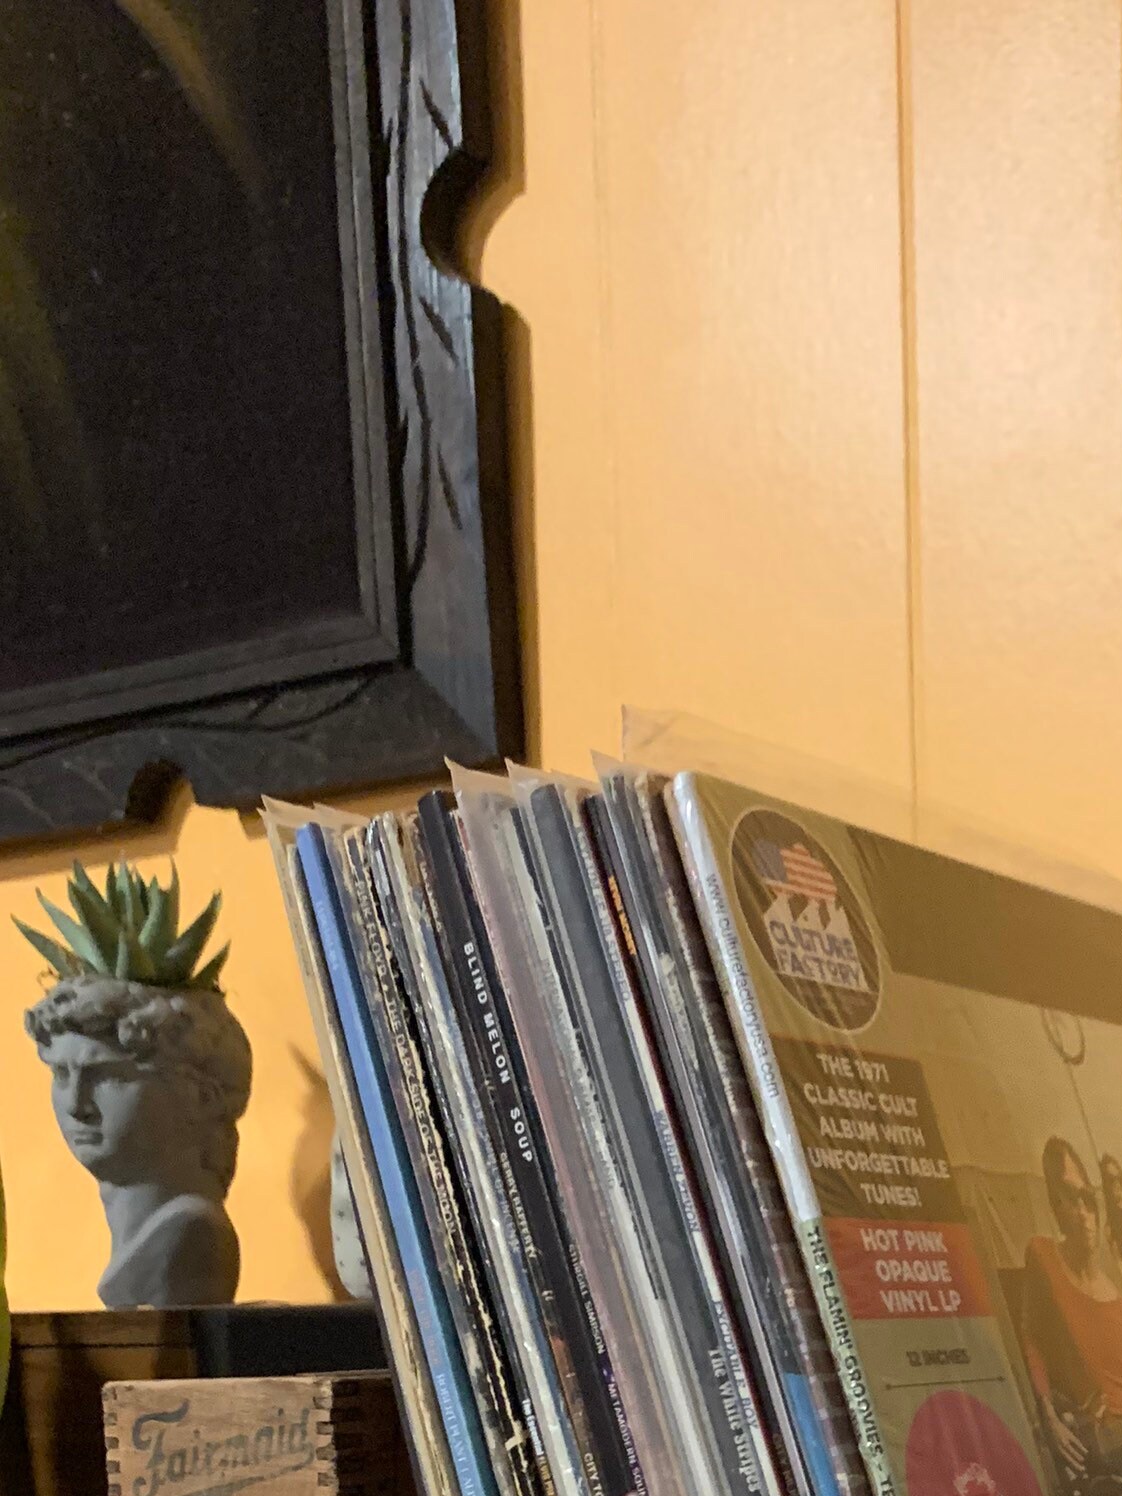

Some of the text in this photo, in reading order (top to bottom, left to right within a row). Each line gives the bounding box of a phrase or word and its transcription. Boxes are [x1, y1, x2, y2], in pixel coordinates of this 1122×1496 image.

[775, 950, 861, 986] FACTORY
[354, 880, 457, 1234] PINK FLOYD THE DARK SIDE OF THE MOON
[462, 941, 488, 1004] BLIND
[483, 1012, 511, 1084] MELON
[509, 1106, 533, 1163] SOUP
[817, 1053, 889, 1083] THE 1971
[804, 1081, 918, 1116] CLASSIC CULT
[820, 1116, 925, 1147] ALBUM WITH
[807, 1147, 951, 1179] UNFORGETTABLE
[497, 1151, 537, 1259] GERRY RAFFERTY
[860, 1228, 948, 1253] HOT PINK
[876, 1259, 951, 1283] OPAQUE
[566, 1243, 588, 1296] STURGILL
[583, 1300, 605, 1354] SIMPSON
[880, 1290, 961, 1312] VINYL LP
[806, 1225, 829, 1266] THE
[818, 1269, 853, 1351] FLAMIN'
[842, 1353, 886, 1457] GROOVIES
[436, 1372, 455, 1420] ROBERT
[449, 1423, 467, 1463] PLANT
[707, 1345, 761, 1493] The White Stripes
[741, 1396, 760, 1430] BOY
[583, 1451, 599, 1482] CITY
